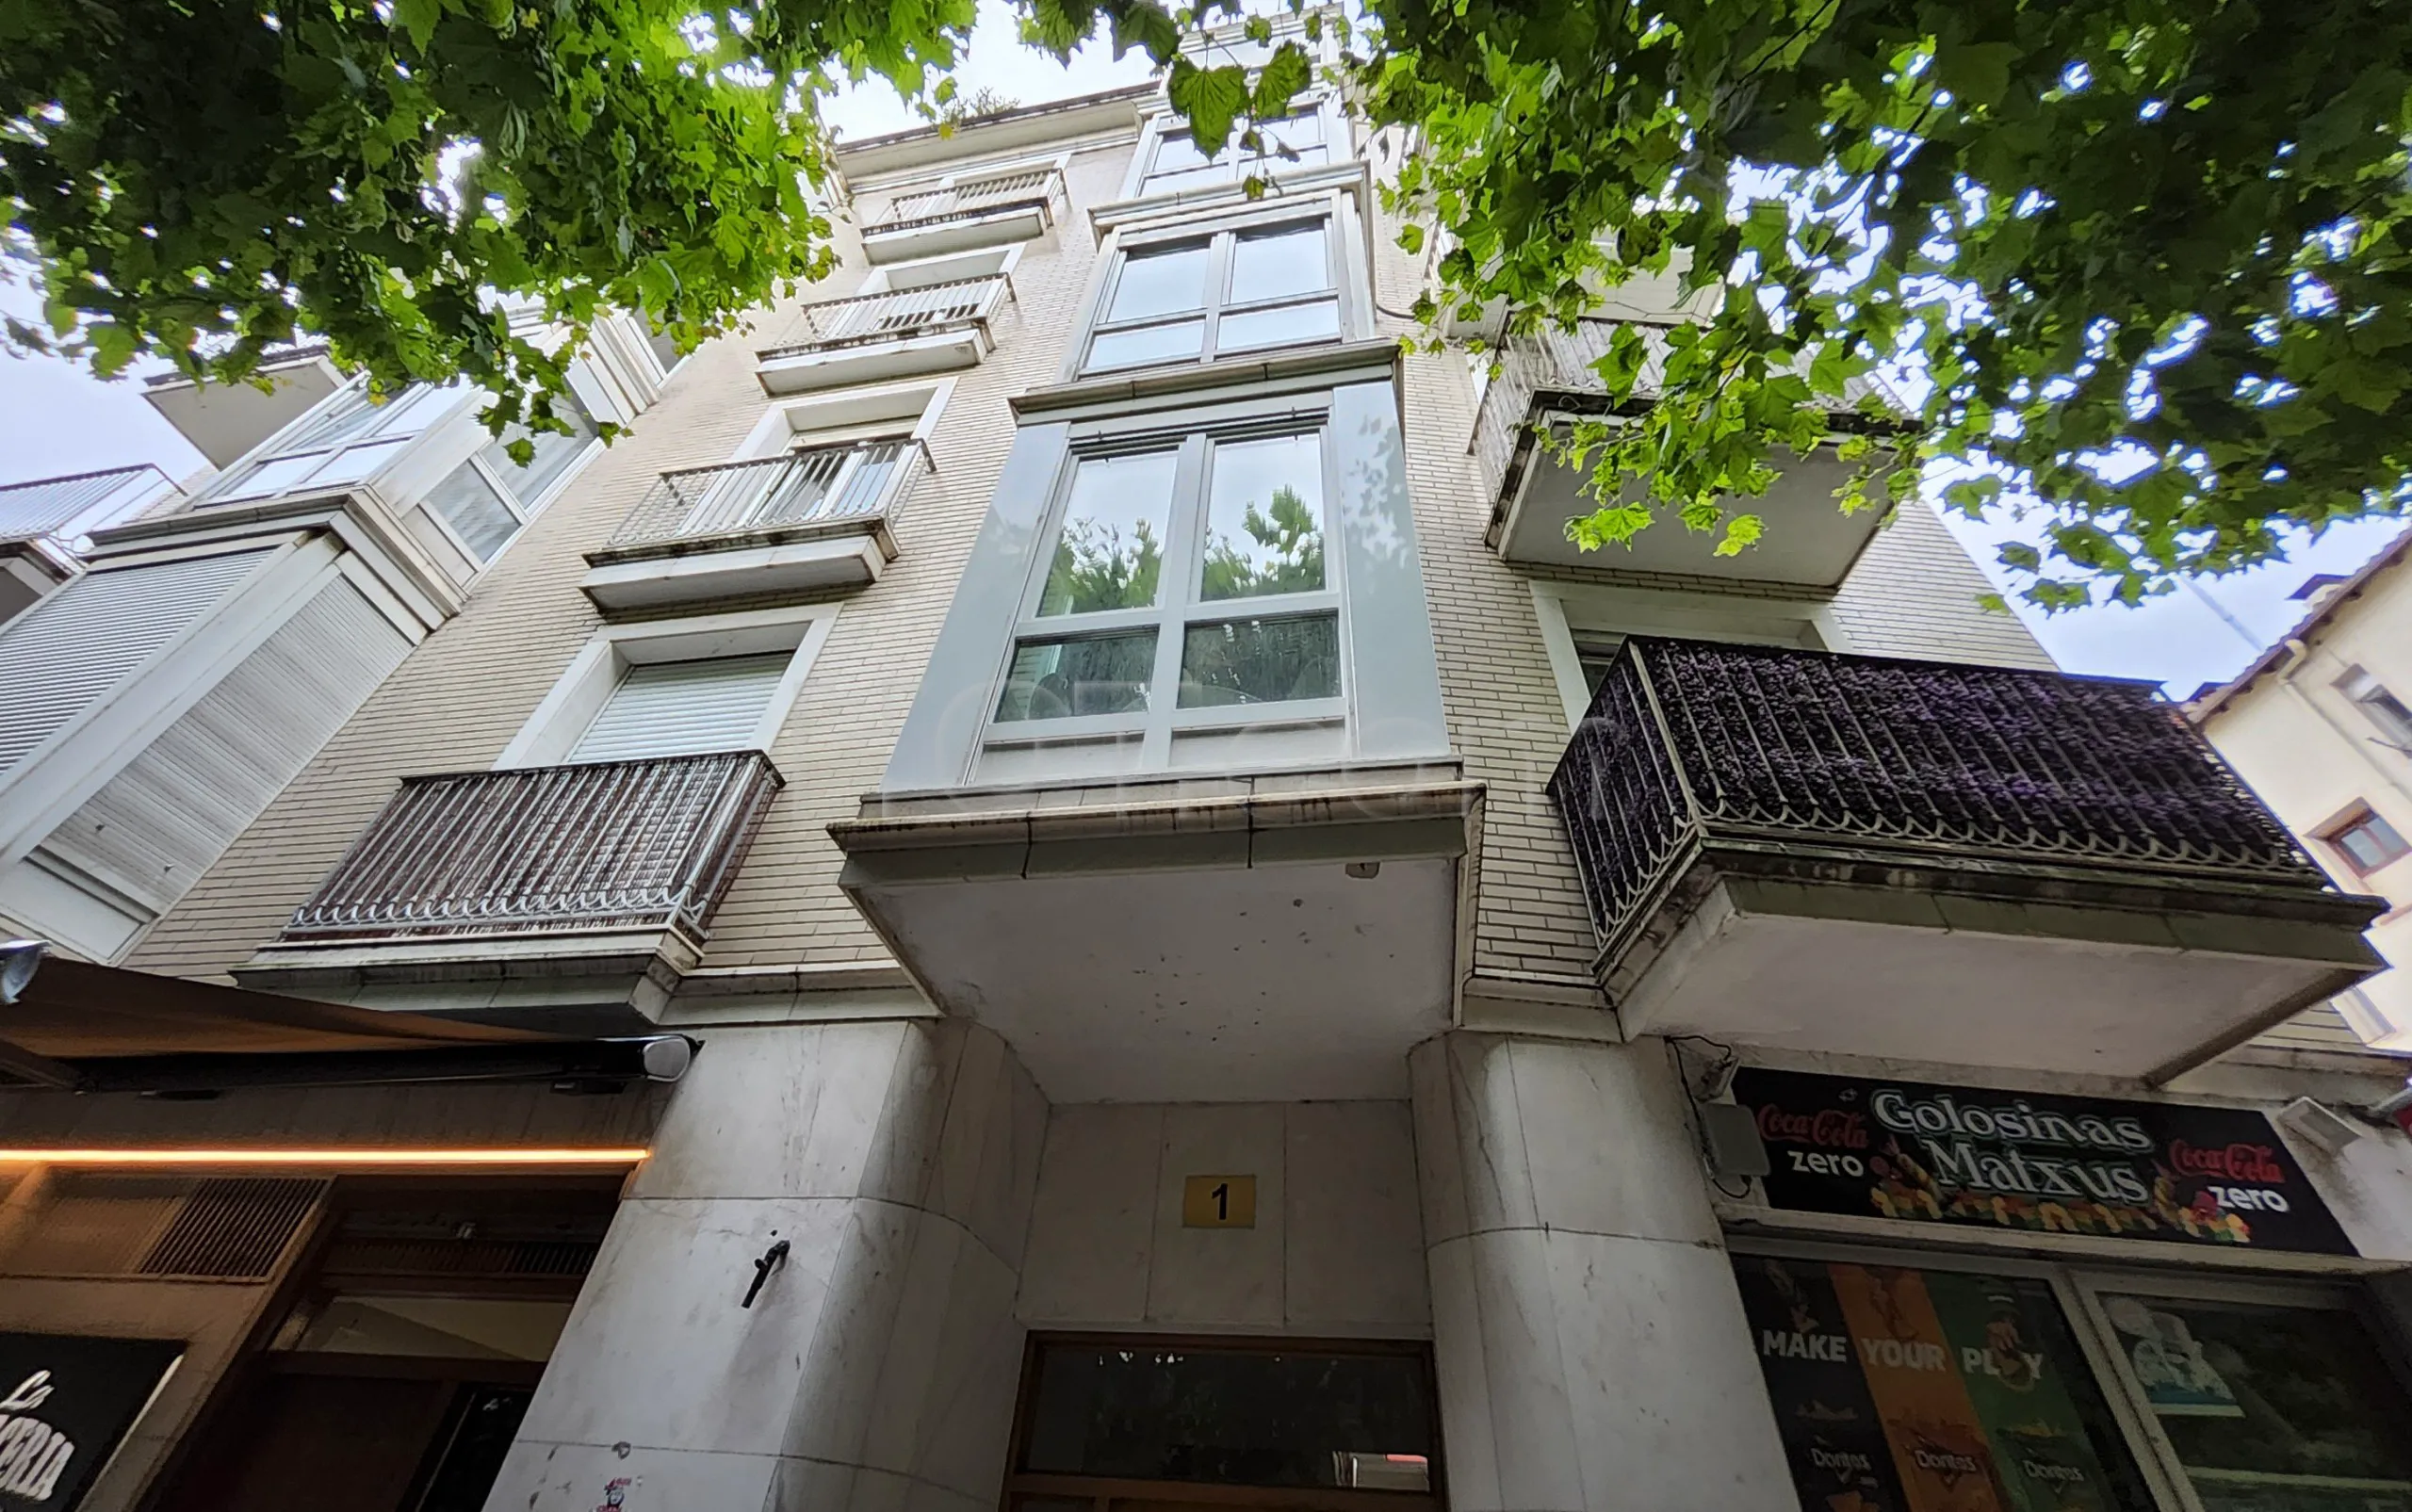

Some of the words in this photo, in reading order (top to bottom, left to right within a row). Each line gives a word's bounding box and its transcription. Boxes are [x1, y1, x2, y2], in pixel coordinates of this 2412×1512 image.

[1757, 1103, 1869, 1149] Coca-Cola
[1870, 1089, 2156, 1155] Golosinas
[1787, 1150, 1865, 1178] zero
[1922, 1138, 2150, 1204] Matxus
[2170, 1139, 2286, 1184] Coca-Cola
[1211, 1182, 1229, 1220] 1
[2208, 1185, 2290, 1213] zero
[1763, 1329, 1848, 1363] MAKE
[1860, 1338, 1947, 1373] YOUR
[1961, 1346, 2043, 1380] PLY
[1810, 1447, 1873, 1471] Doritos
[1914, 1449, 1978, 1472] Doritos
[2021, 1459, 2084, 1482] Doritos
